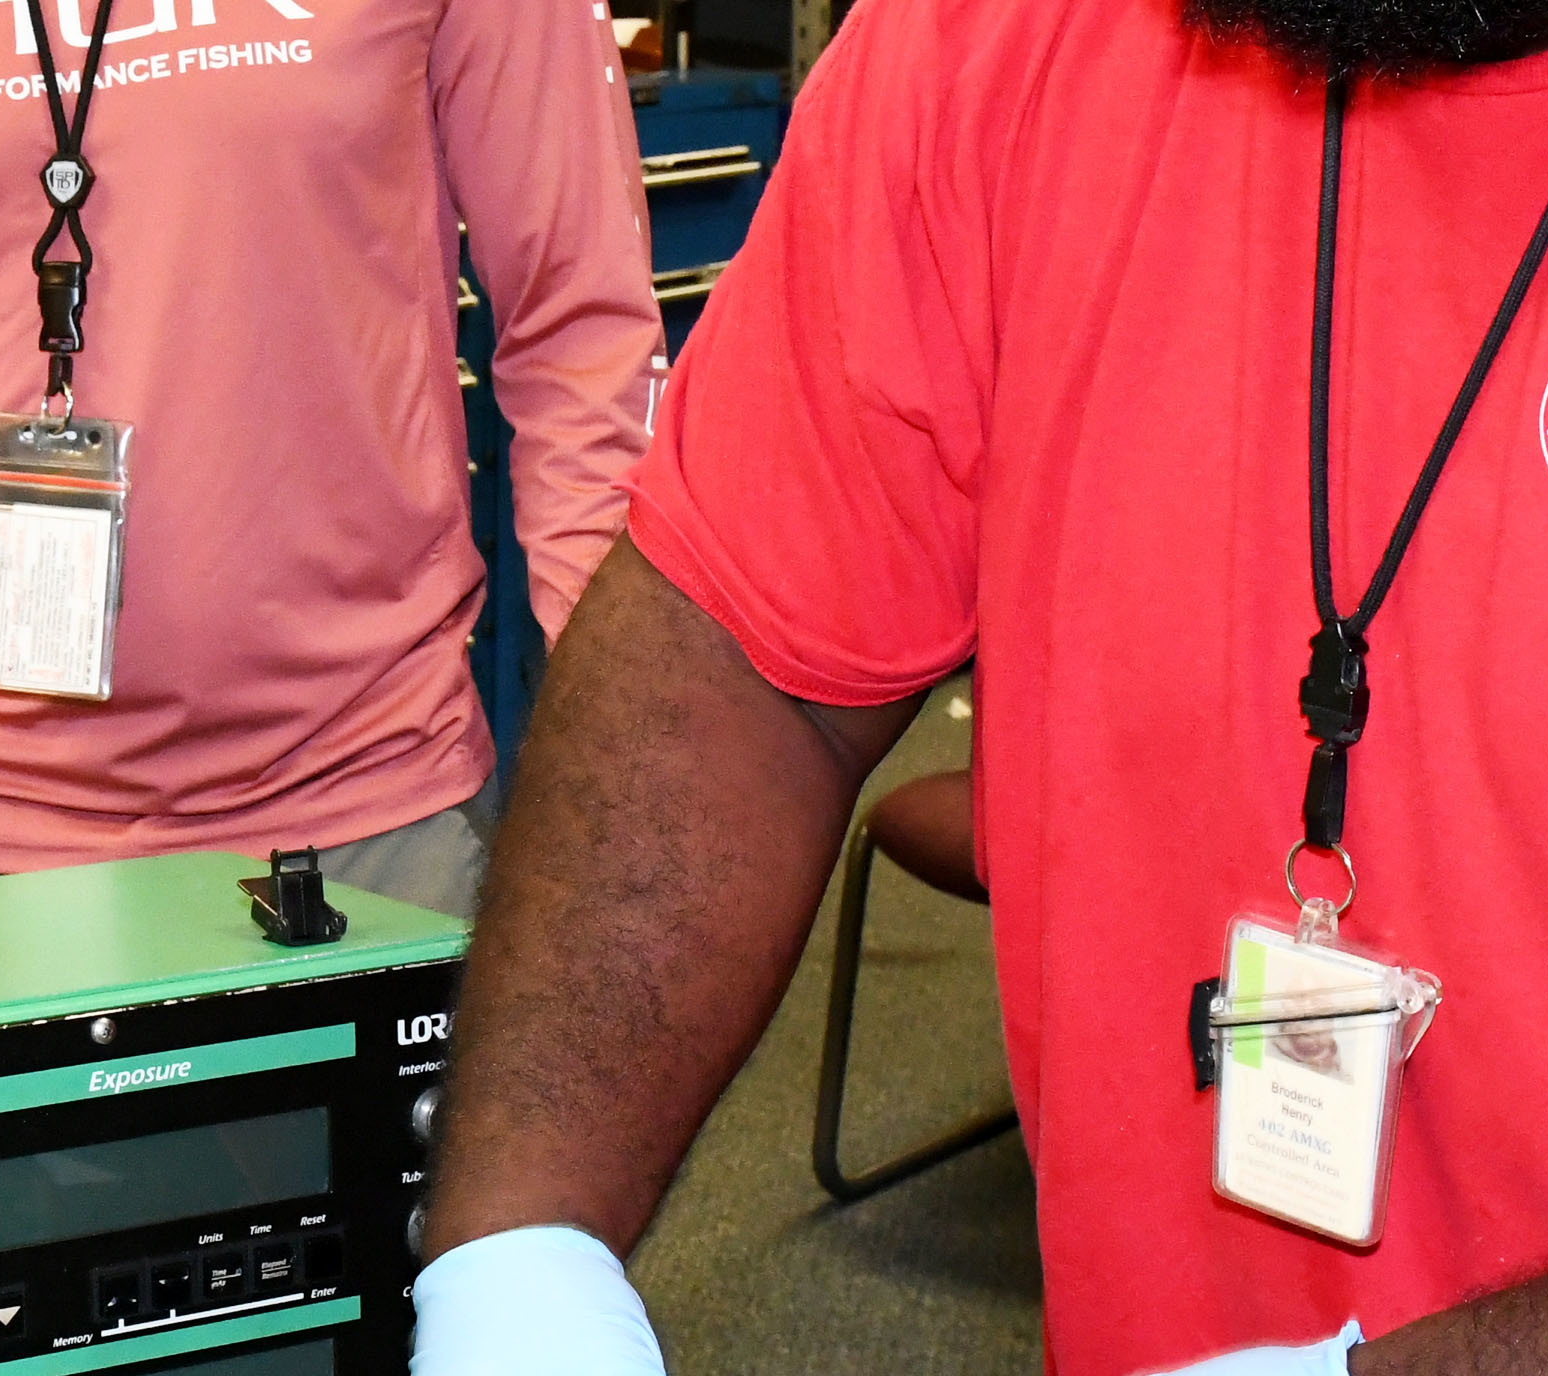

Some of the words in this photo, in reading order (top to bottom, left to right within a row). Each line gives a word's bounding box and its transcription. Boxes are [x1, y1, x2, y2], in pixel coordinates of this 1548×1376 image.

[178, 39, 313, 70] FISHING
[397, 1011, 454, 1046] LOR
[88, 1060, 192, 1094] Exposure
[1271, 1081, 1324, 1110] Broderick
[1281, 1103, 1313, 1127] Henry
[1247, 1133, 1309, 1166] Controlled
[1313, 1159, 1341, 1178] Area
[249, 1224, 273, 1235] Time
[300, 1214, 327, 1226] Reset
[198, 1232, 224, 1245] Units
[310, 1286, 337, 1299] Enter
[53, 1331, 93, 1348] Memory
